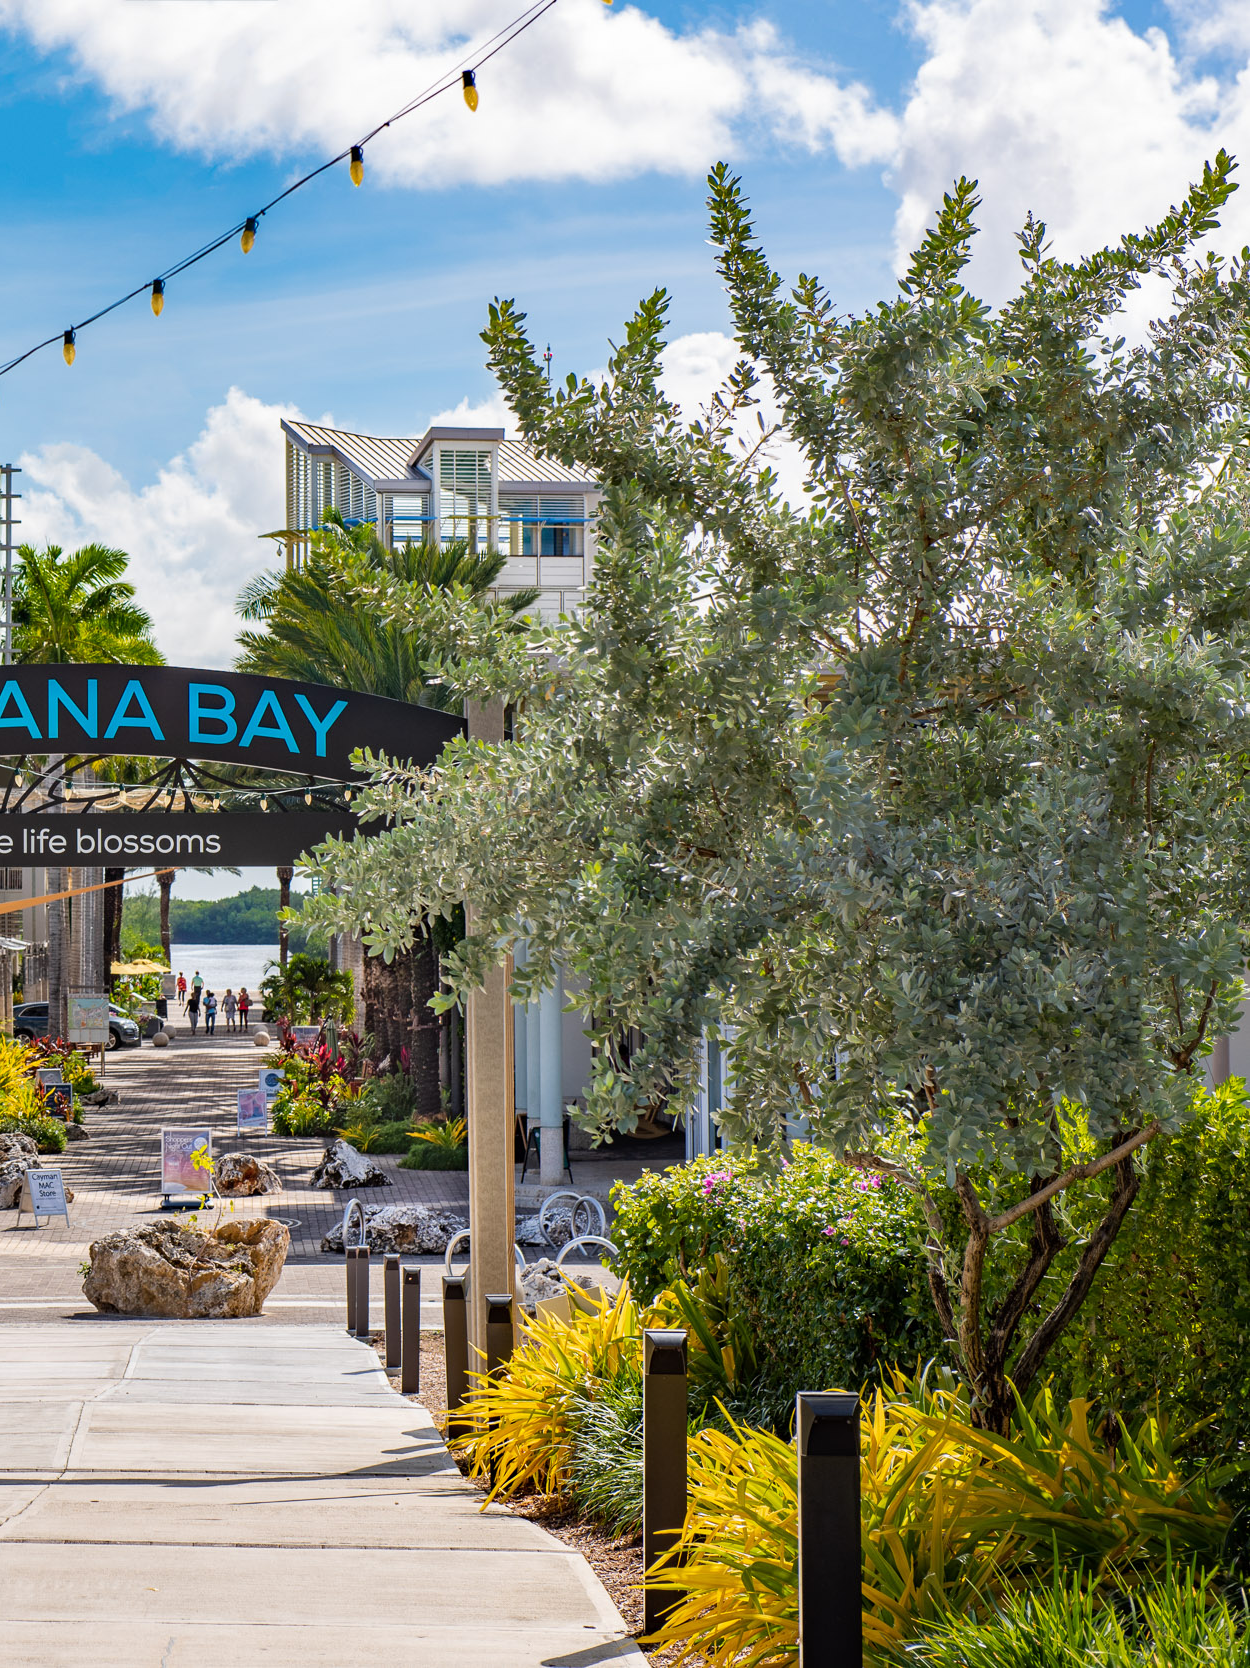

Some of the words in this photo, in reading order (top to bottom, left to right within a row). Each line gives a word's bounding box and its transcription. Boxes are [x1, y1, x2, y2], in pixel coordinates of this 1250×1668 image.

[188, 682, 348, 757] BAY
[23, 828, 67, 854] life
[76, 828, 222, 854] blossoms
[31, 1173, 58, 1182] Cayman
